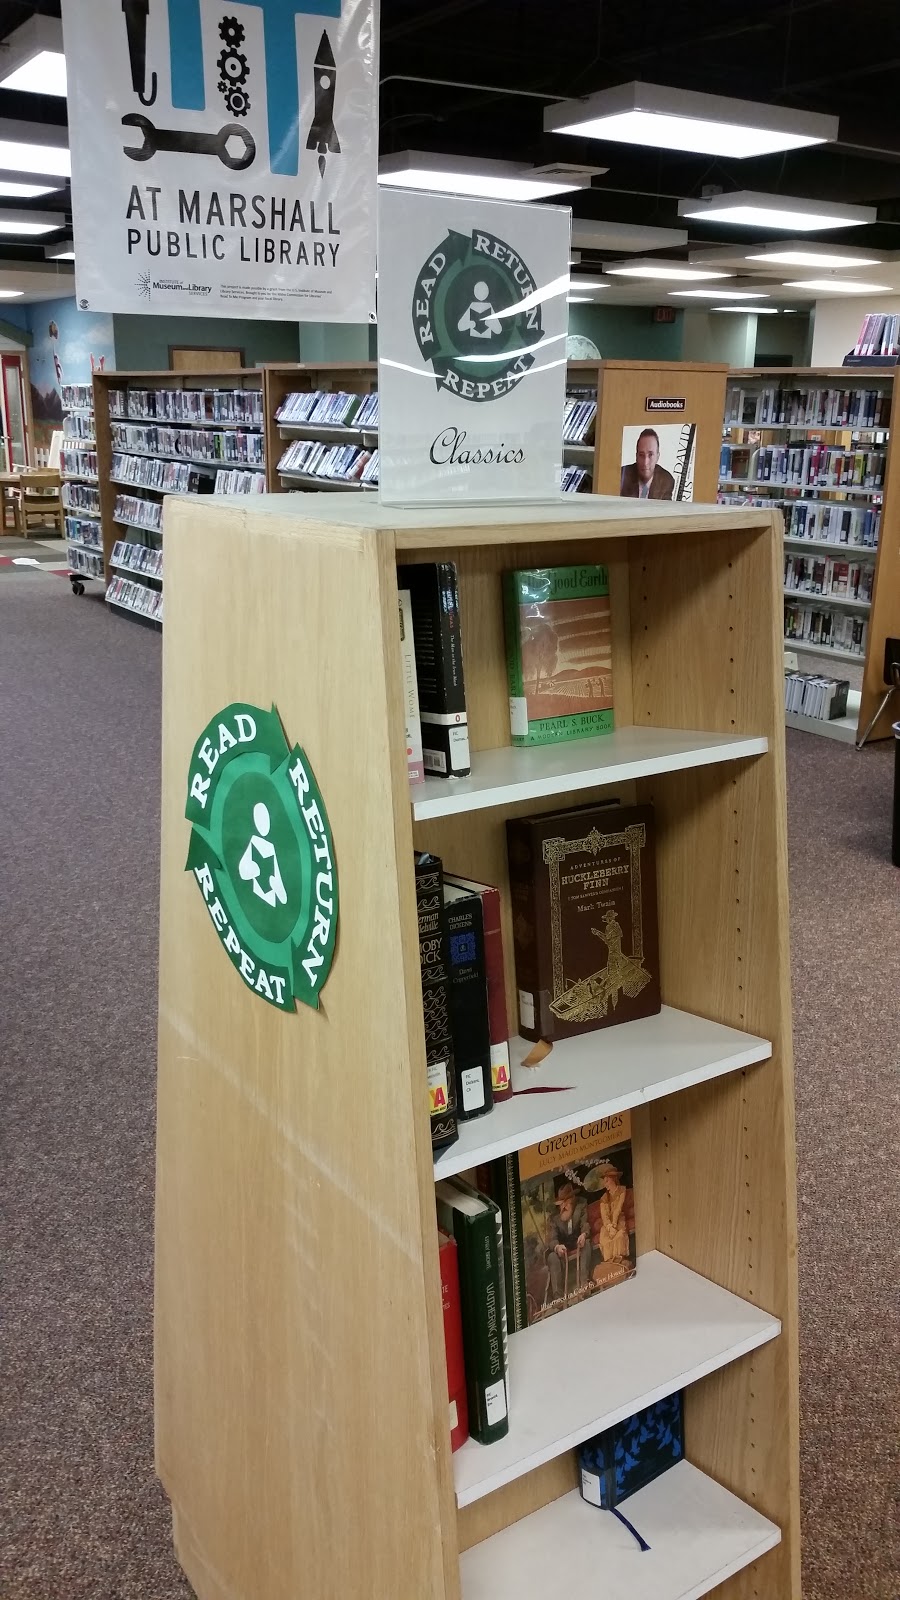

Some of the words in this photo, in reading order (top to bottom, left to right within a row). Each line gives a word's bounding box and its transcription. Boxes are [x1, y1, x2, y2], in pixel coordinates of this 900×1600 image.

[126, 185, 161, 221] AT
[178, 189, 341, 235] MARSHALL
[128, 228, 226, 260] PUBLIC
[240, 236, 340, 267] LIBRARY
[152, 282, 183, 290] Museum
[188, 283, 213, 293] Library
[416, 251, 447, 345] READ
[442, 354, 529, 399] REPEAT
[649, 400, 684, 409] Audiobooks
[429, 426, 526, 465] Classics
[673, 423, 691, 475] DAVID
[408, 689, 416, 719] WOME
[540, 720, 568, 732] PEARL
[581, 714, 605, 725] BUCK
[566, 726, 594, 736] LIBRARY
[596, 723, 611, 731] BOOK
[190, 713, 257, 809] READ
[288, 757, 333, 988] RETURN
[561, 864, 630, 885] HUCKLEBERRY
[570, 858, 612, 871] ADVENTURES
[583, 877, 610, 890] FINN
[419, 912, 439, 923] erman
[448, 913, 473, 924] CHARLES
[577, 903, 595, 912] Mark
[596, 900, 616, 909] Twain
[194, 862, 286, 1005] REPEAT
[419, 920, 439, 934] elville
[449, 920, 473, 930] DICKENS
[420, 937, 443, 953] OBY
[537, 1132, 577, 1156] Green
[580, 1114, 623, 1140] Gables
[558, 1148, 579, 1159] MAUD
[580, 1130, 623, 1152] MONTGOMERY
[486, 1282, 497, 1338] WUTHERING
[489, 1336, 500, 1375] HEIGHTS
